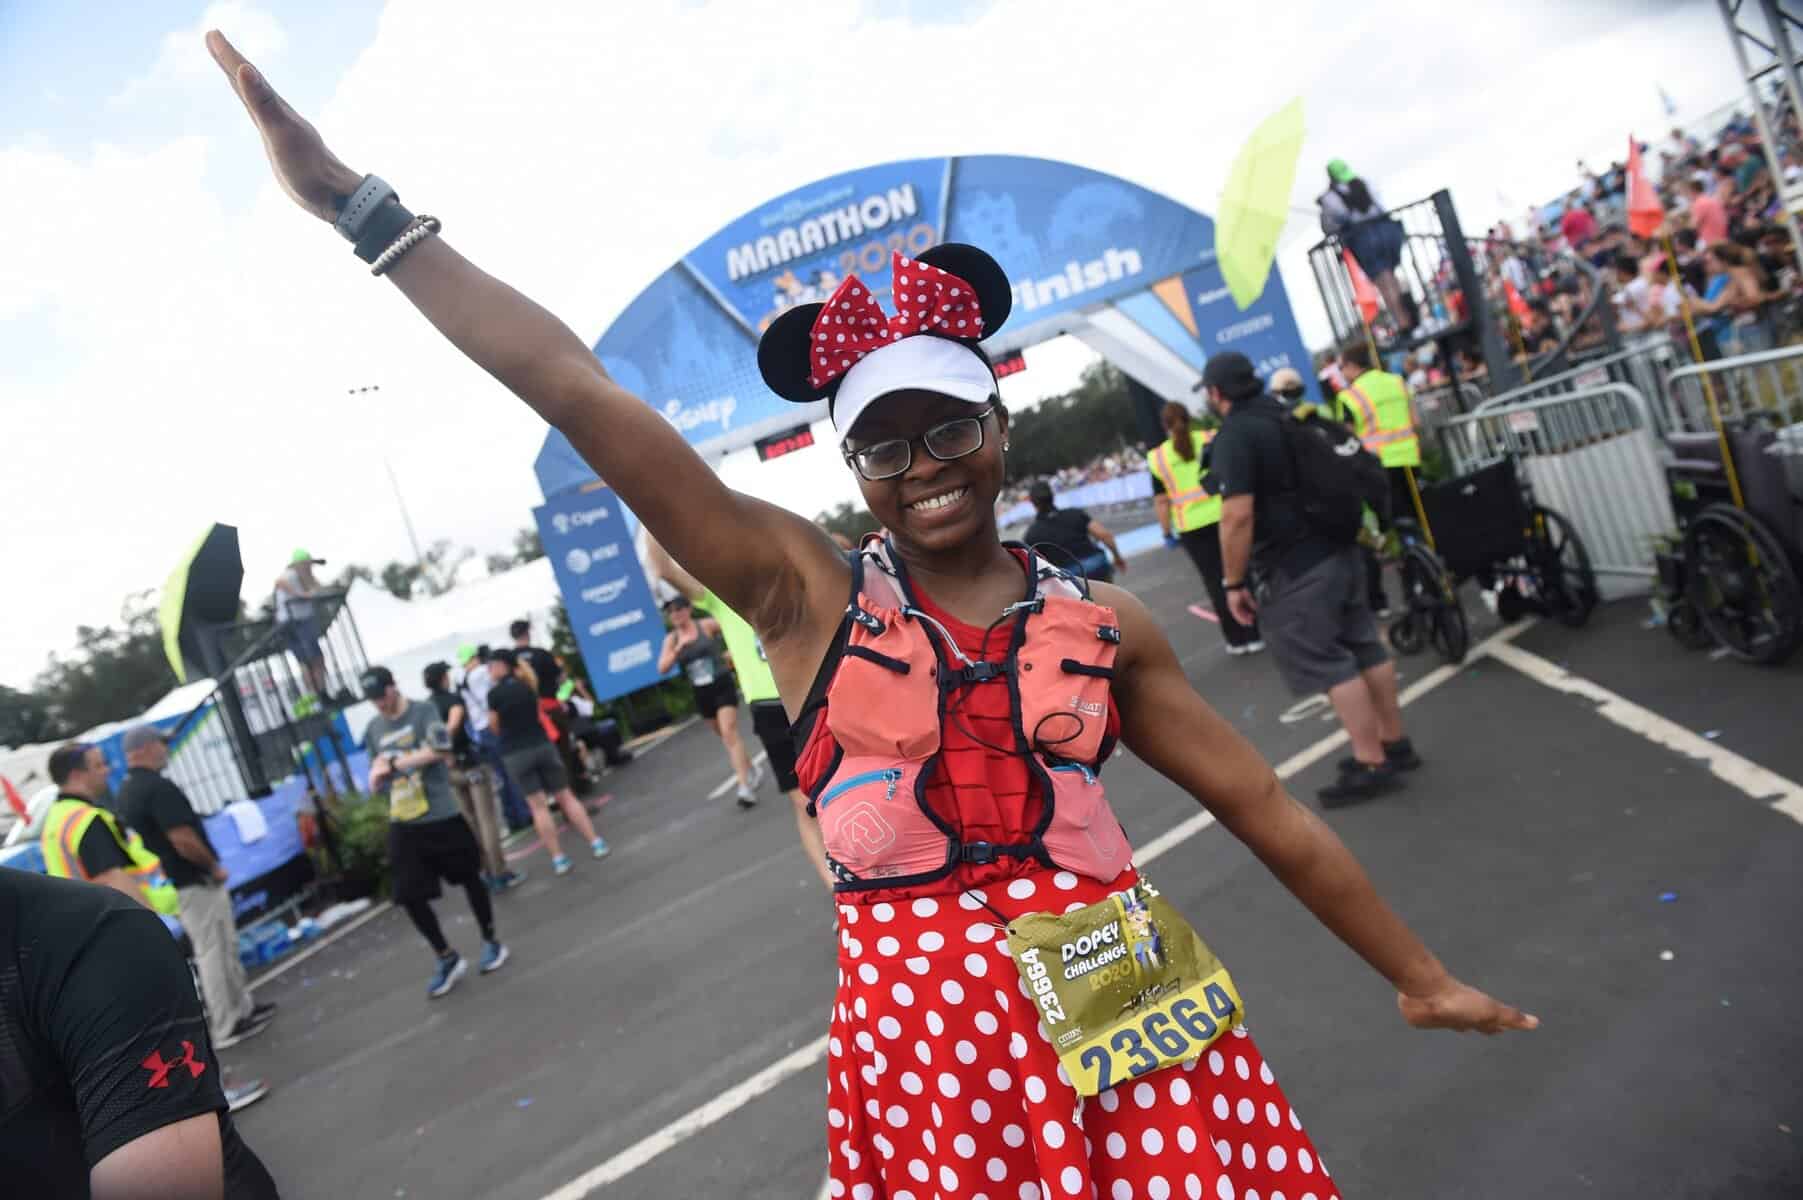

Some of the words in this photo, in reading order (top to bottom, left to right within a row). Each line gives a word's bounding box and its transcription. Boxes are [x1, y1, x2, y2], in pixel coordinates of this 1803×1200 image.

[727, 184, 917, 281] MARATHON
[839, 223, 936, 279] 2020
[1012, 248, 1143, 311] inish
[1061, 921, 1120, 963] DOPEY
[1064, 943, 1128, 981] CHALLENGE
[1020, 947, 1066, 1025] 23664
[1087, 960, 1133, 991] 2020
[1080, 982, 1236, 1093] 23664
